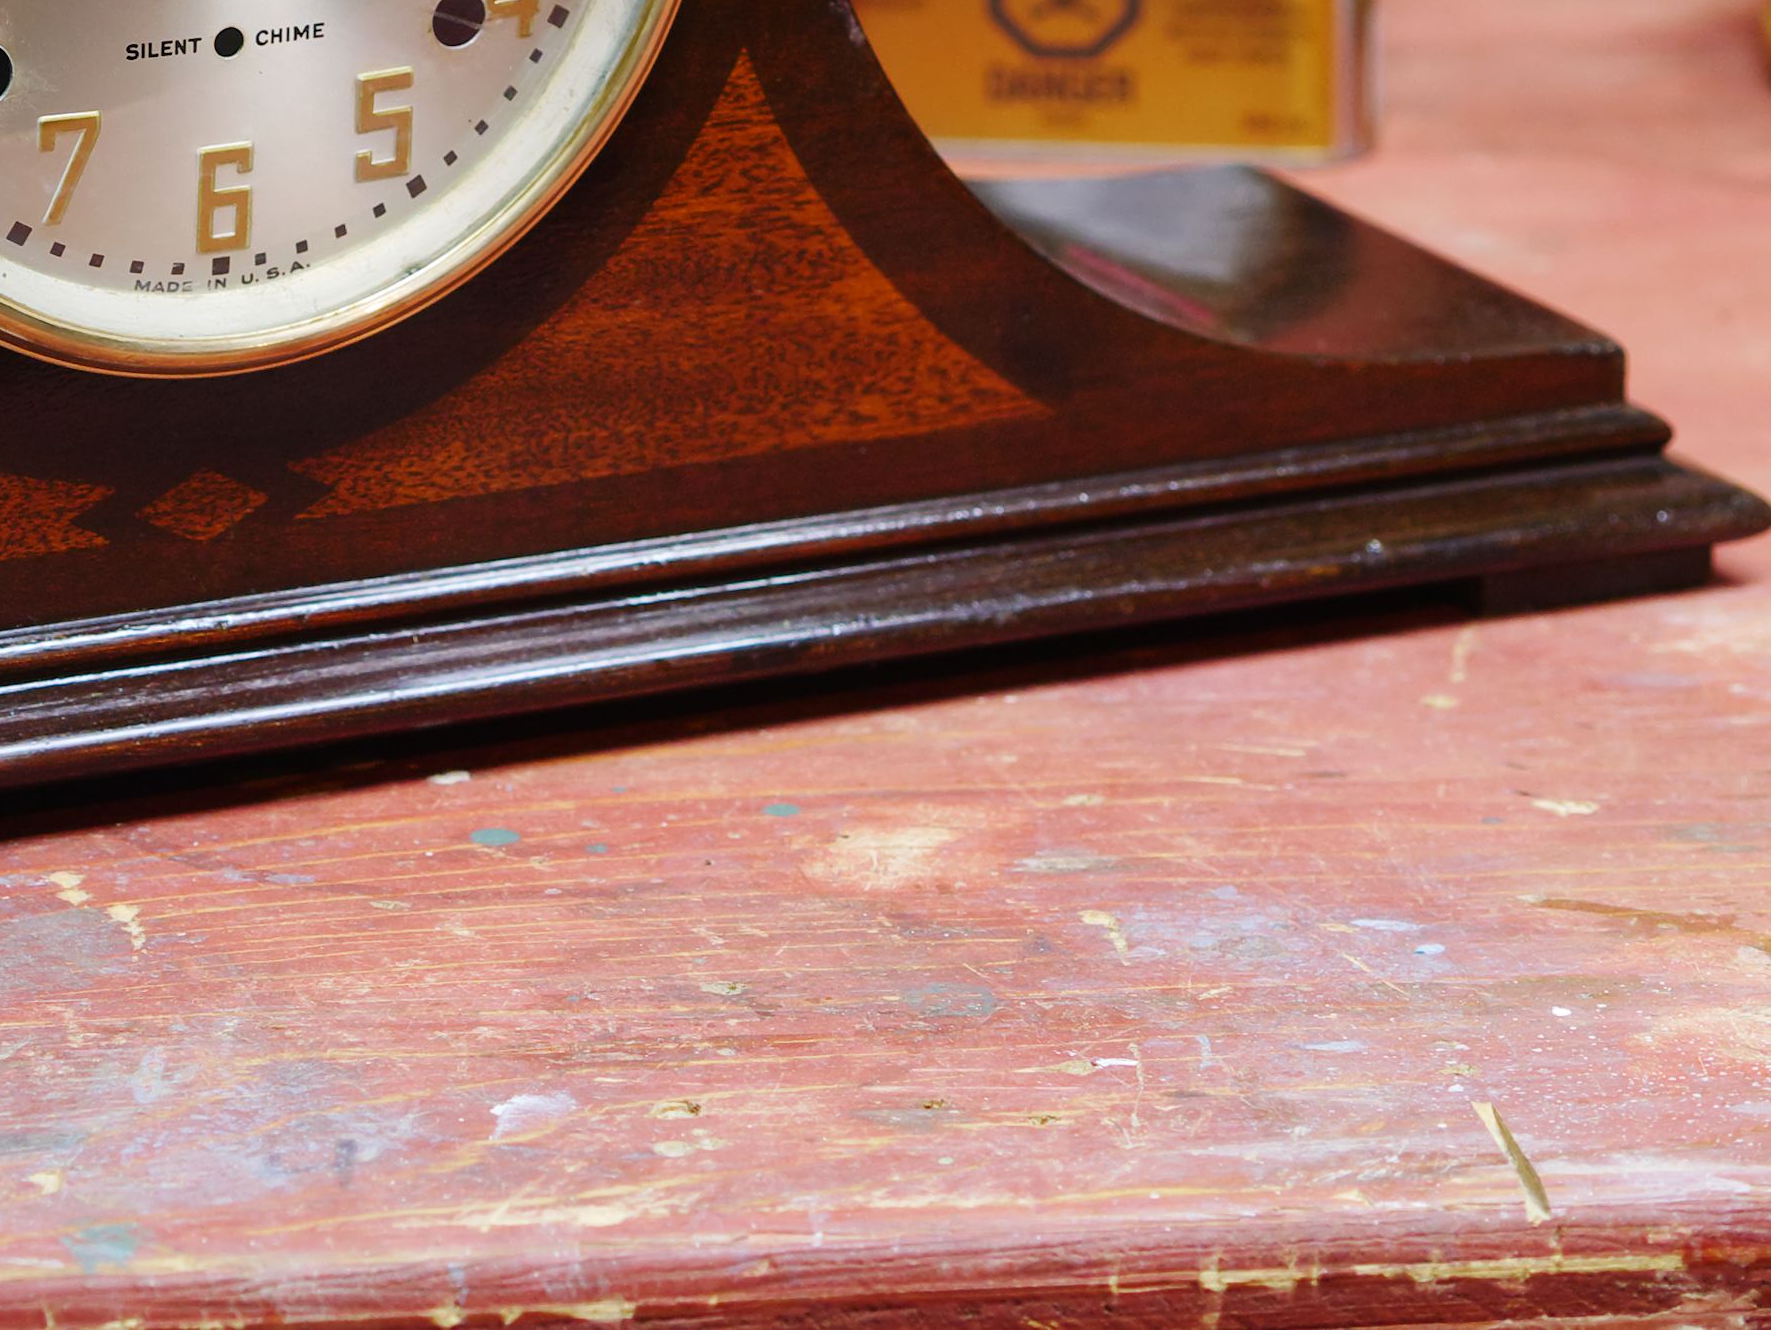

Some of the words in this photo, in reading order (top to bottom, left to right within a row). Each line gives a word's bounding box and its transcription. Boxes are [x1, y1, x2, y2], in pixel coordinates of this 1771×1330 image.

[126, 37, 202, 60] SILENT
[255, 22, 325, 46] CHIME
[37, 110, 103, 226] 7
[354, 66, 414, 184] 5
[195, 140, 254, 255] 6
[134, 279, 194, 293] MADE
[207, 277, 227, 291] IN
